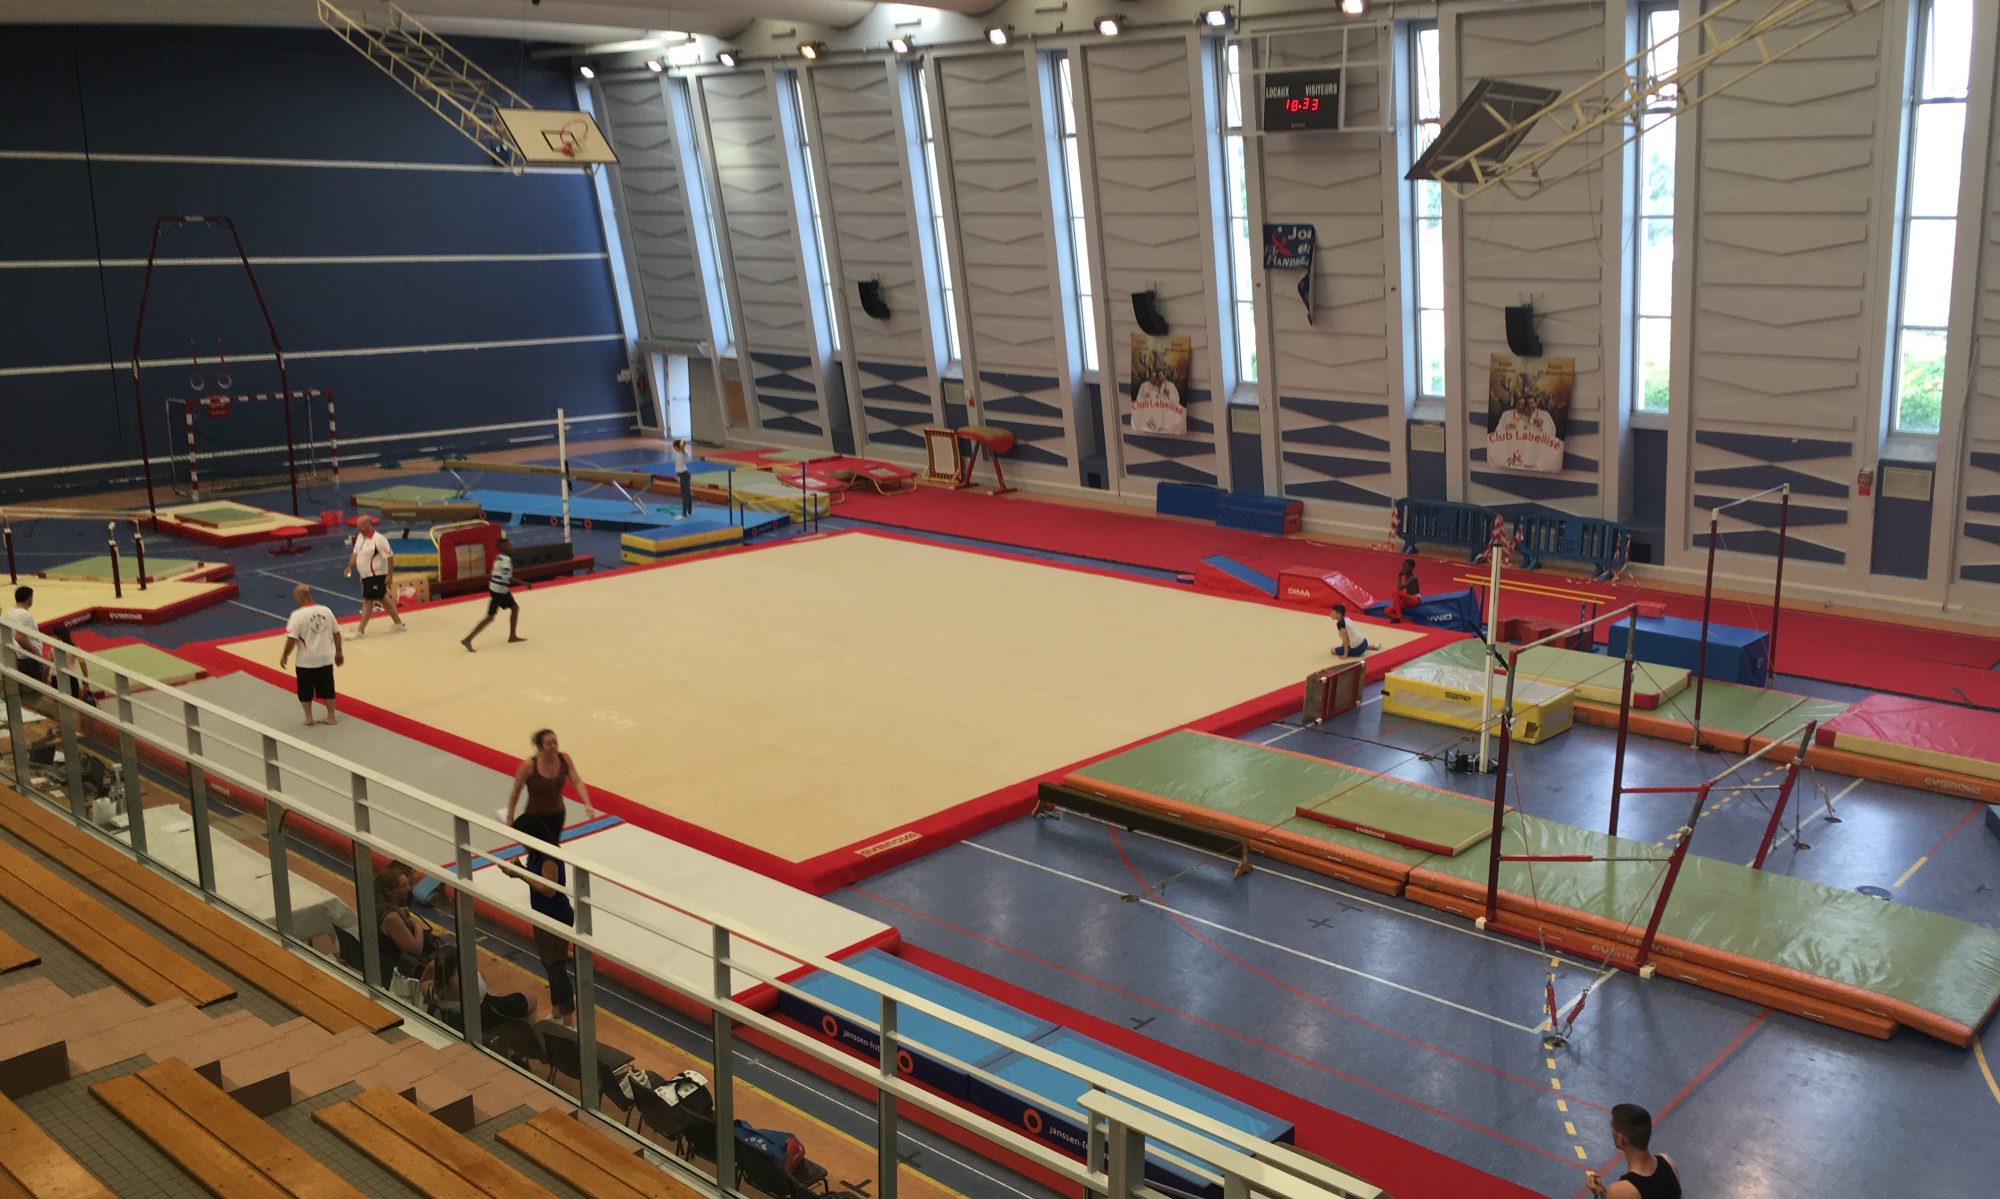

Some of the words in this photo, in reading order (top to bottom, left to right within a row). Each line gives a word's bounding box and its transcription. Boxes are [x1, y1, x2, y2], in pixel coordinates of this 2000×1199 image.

[1265, 85, 1290, 99] LOCAUX
[1305, 82, 1338, 96] VISITEURS
[1132, 399, 1151, 411] Club
[1489, 431, 1513, 443] Club
[1288, 587, 1311, 598] DIMA
